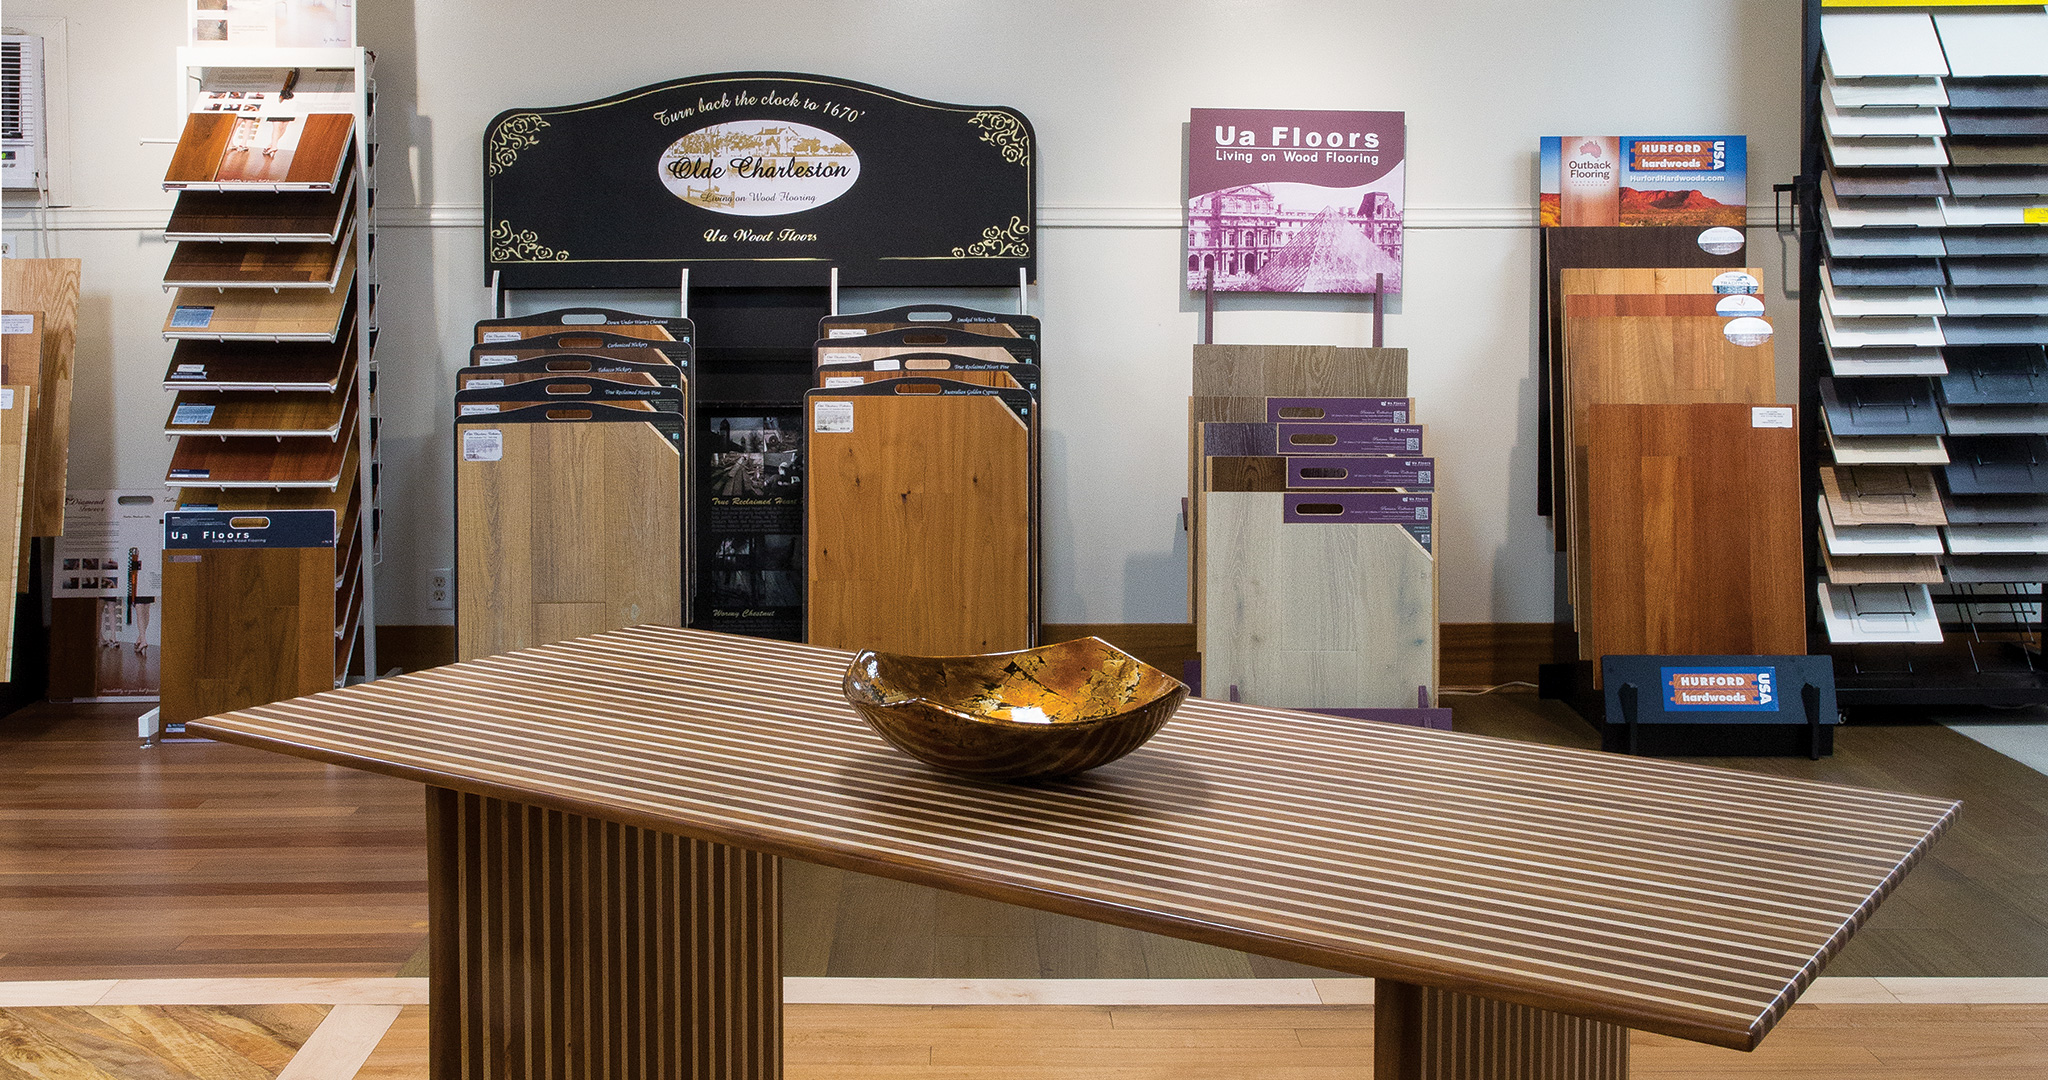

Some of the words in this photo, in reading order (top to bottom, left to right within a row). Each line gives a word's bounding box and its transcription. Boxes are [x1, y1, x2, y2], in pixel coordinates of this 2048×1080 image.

[654, 107, 694, 126] Turn
[698, 92, 732, 113] back
[735, 90, 758, 106] the
[761, 90, 801, 108] clock
[803, 98, 818, 111] to
[1215, 125, 1256, 146] Ua
[1272, 126, 1380, 149] Floors
[1642, 144, 1701, 153] HURFORD
[1216, 150, 1253, 164] Living
[1261, 153, 1276, 162] on
[1284, 151, 1318, 163] Wood
[1326, 152, 1379, 166] Flooring
[1714, 141, 1725, 170] USA
[668, 156, 726, 180] Olde
[730, 156, 851, 178] Charleston
[1569, 160, 1611, 169] Outback
[1642, 158, 1701, 168] hardwoods
[1570, 169, 1610, 180] Flooring
[1630, 174, 1725, 183] HurfordHardwoods.com
[701, 193, 734, 204] Living
[749, 192, 776, 202] Wood
[779, 192, 816, 204] Flooring
[703, 228, 728, 242] Ua
[734, 228, 773, 242] Wood
[776, 228, 818, 242] Floors
[712, 497, 729, 506] True
[732, 497, 772, 506] Reclaimed
[775, 497, 797, 505] Heart
[171, 532, 188, 540] Ua
[203, 531, 250, 539] Floors
[712, 609, 740, 618] Wormy
[741, 608, 776, 618] Chestnut
[1681, 677, 1745, 686] HURFORD
[1757, 673, 1772, 704] USA
[1682, 692, 1746, 702] hardwoods
